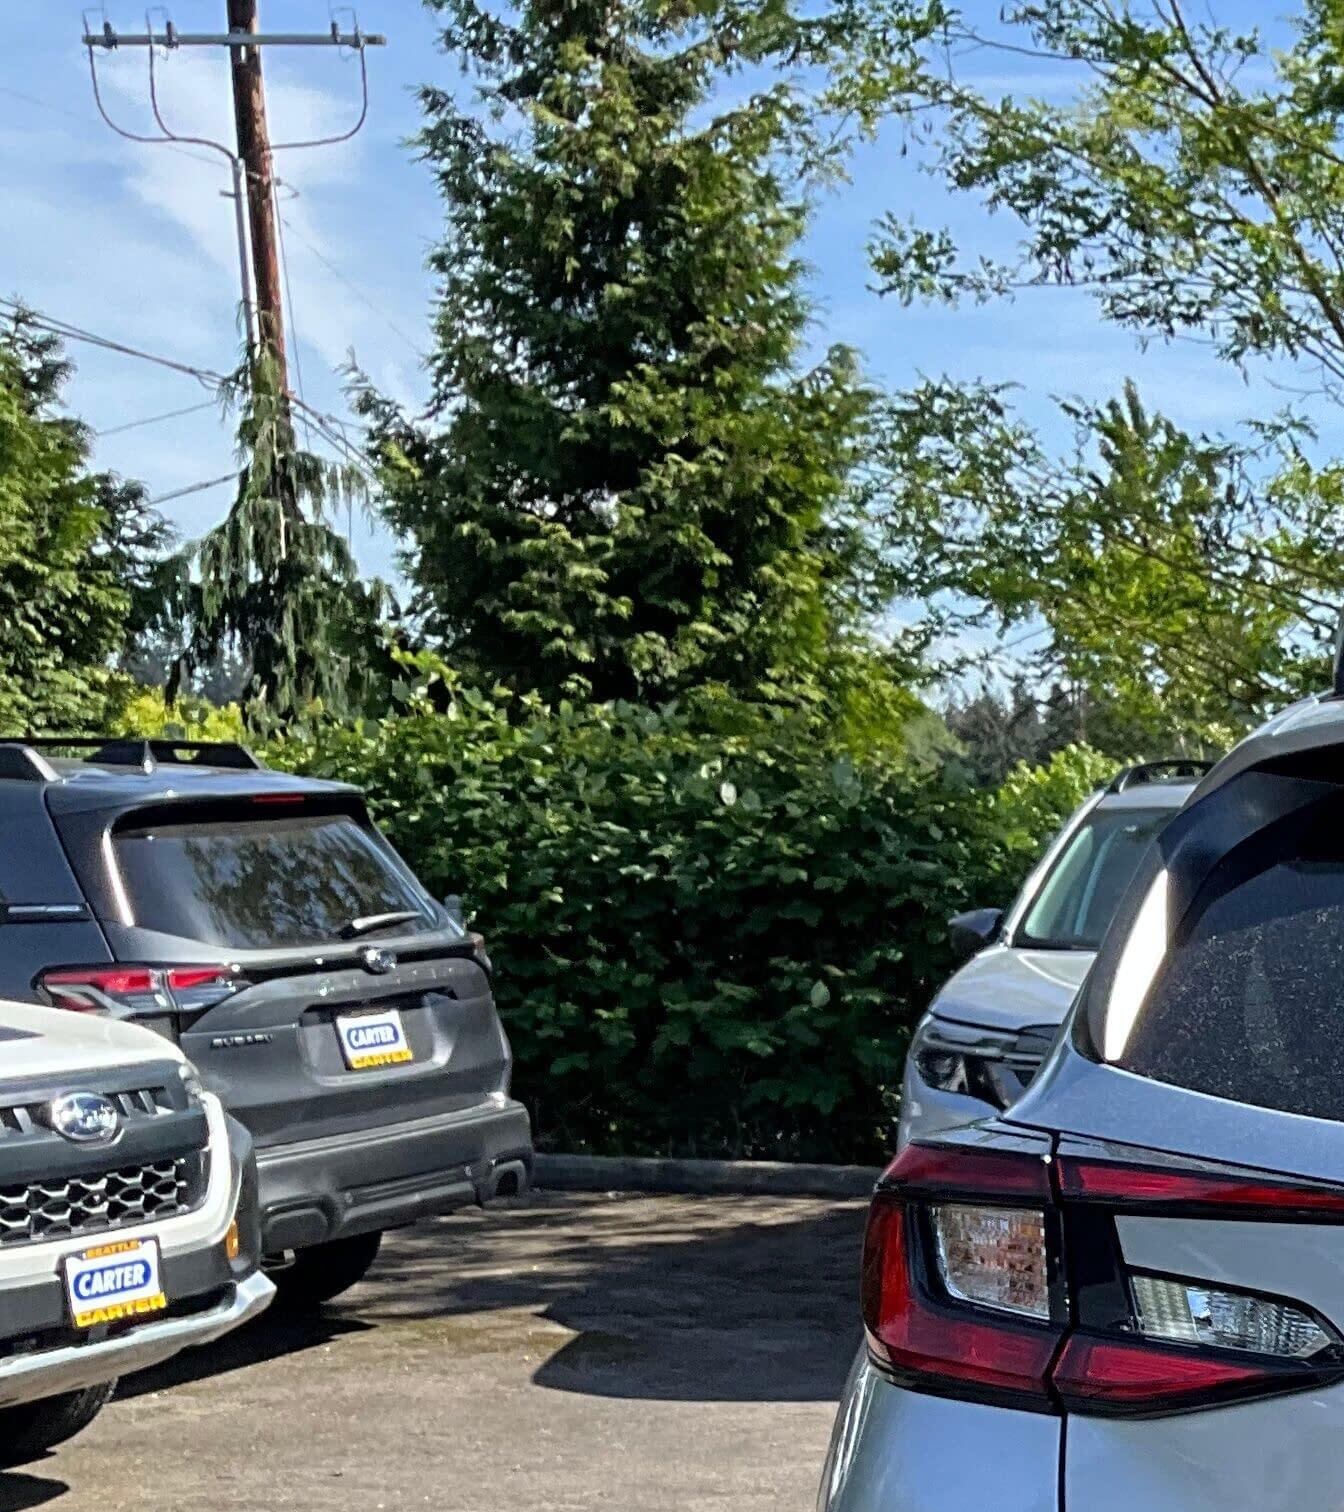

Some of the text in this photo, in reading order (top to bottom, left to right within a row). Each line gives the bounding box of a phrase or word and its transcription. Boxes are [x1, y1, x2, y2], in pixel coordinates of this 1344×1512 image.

[349, 1026, 396, 1048] CARTER
[86, 1239, 139, 1259] SEATTLE
[79, 1263, 145, 1297] CARTER
[76, 1293, 166, 1327] CARTER
